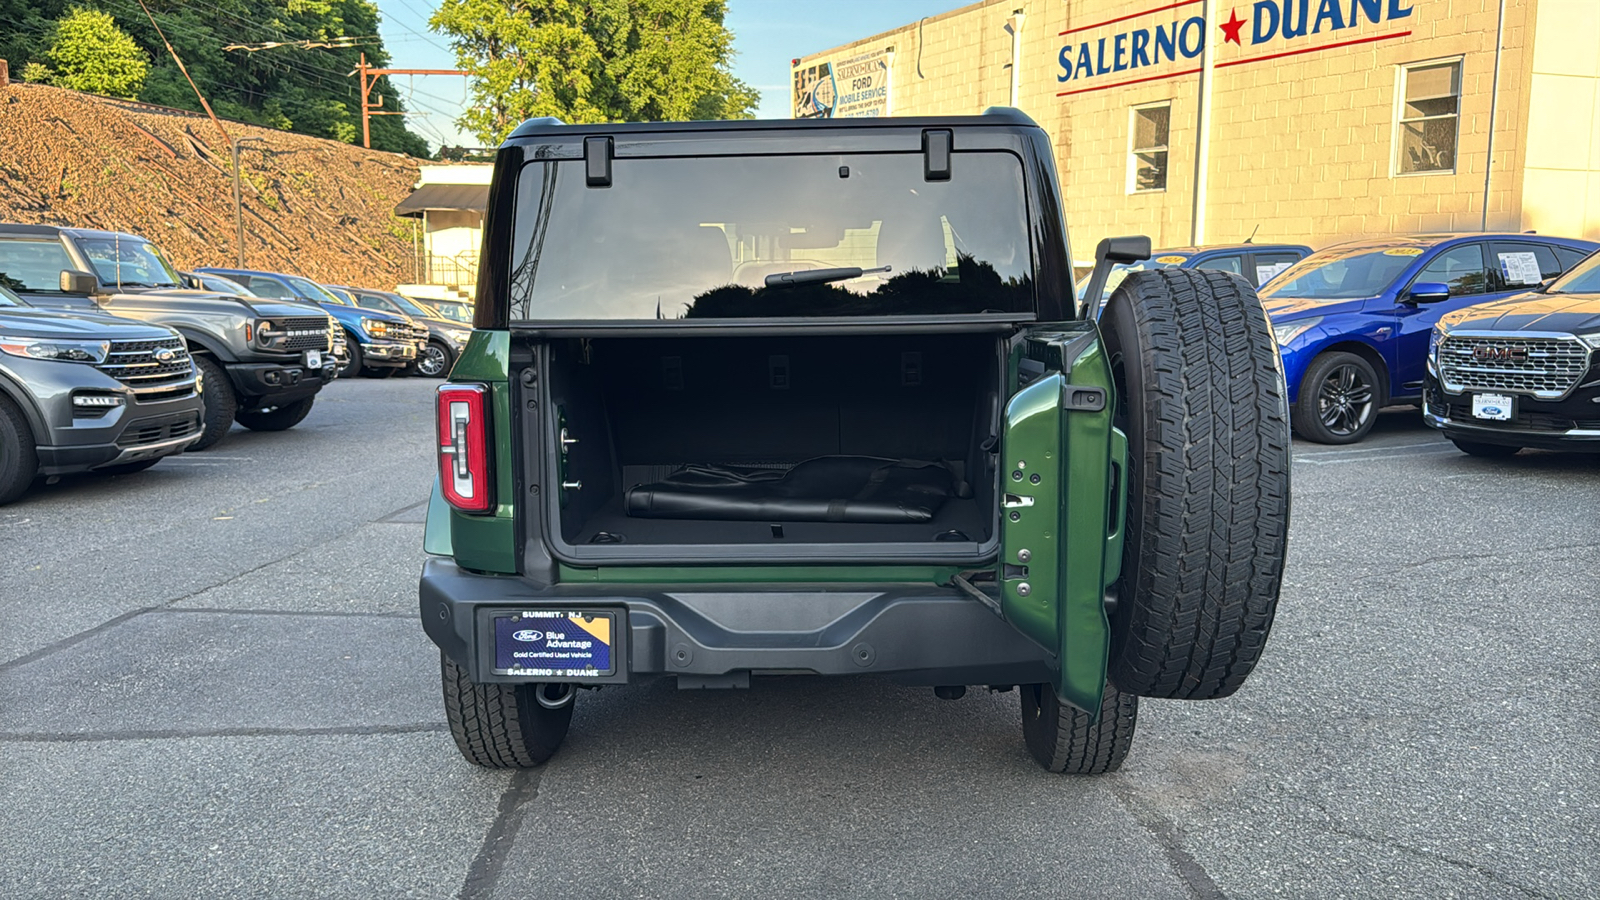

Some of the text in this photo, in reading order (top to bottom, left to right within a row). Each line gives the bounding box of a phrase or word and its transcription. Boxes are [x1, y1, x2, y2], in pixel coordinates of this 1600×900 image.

[1057, 16, 1205, 82] SALERNO
[852, 76, 872, 91] FORD
[840, 86, 886, 105] MOBILE SERVICE
[1473, 346, 1528, 361] GMC
[518, 631, 538, 640] Ford
[546, 632, 565, 640] Blue
[546, 640, 592, 649] Advantage
